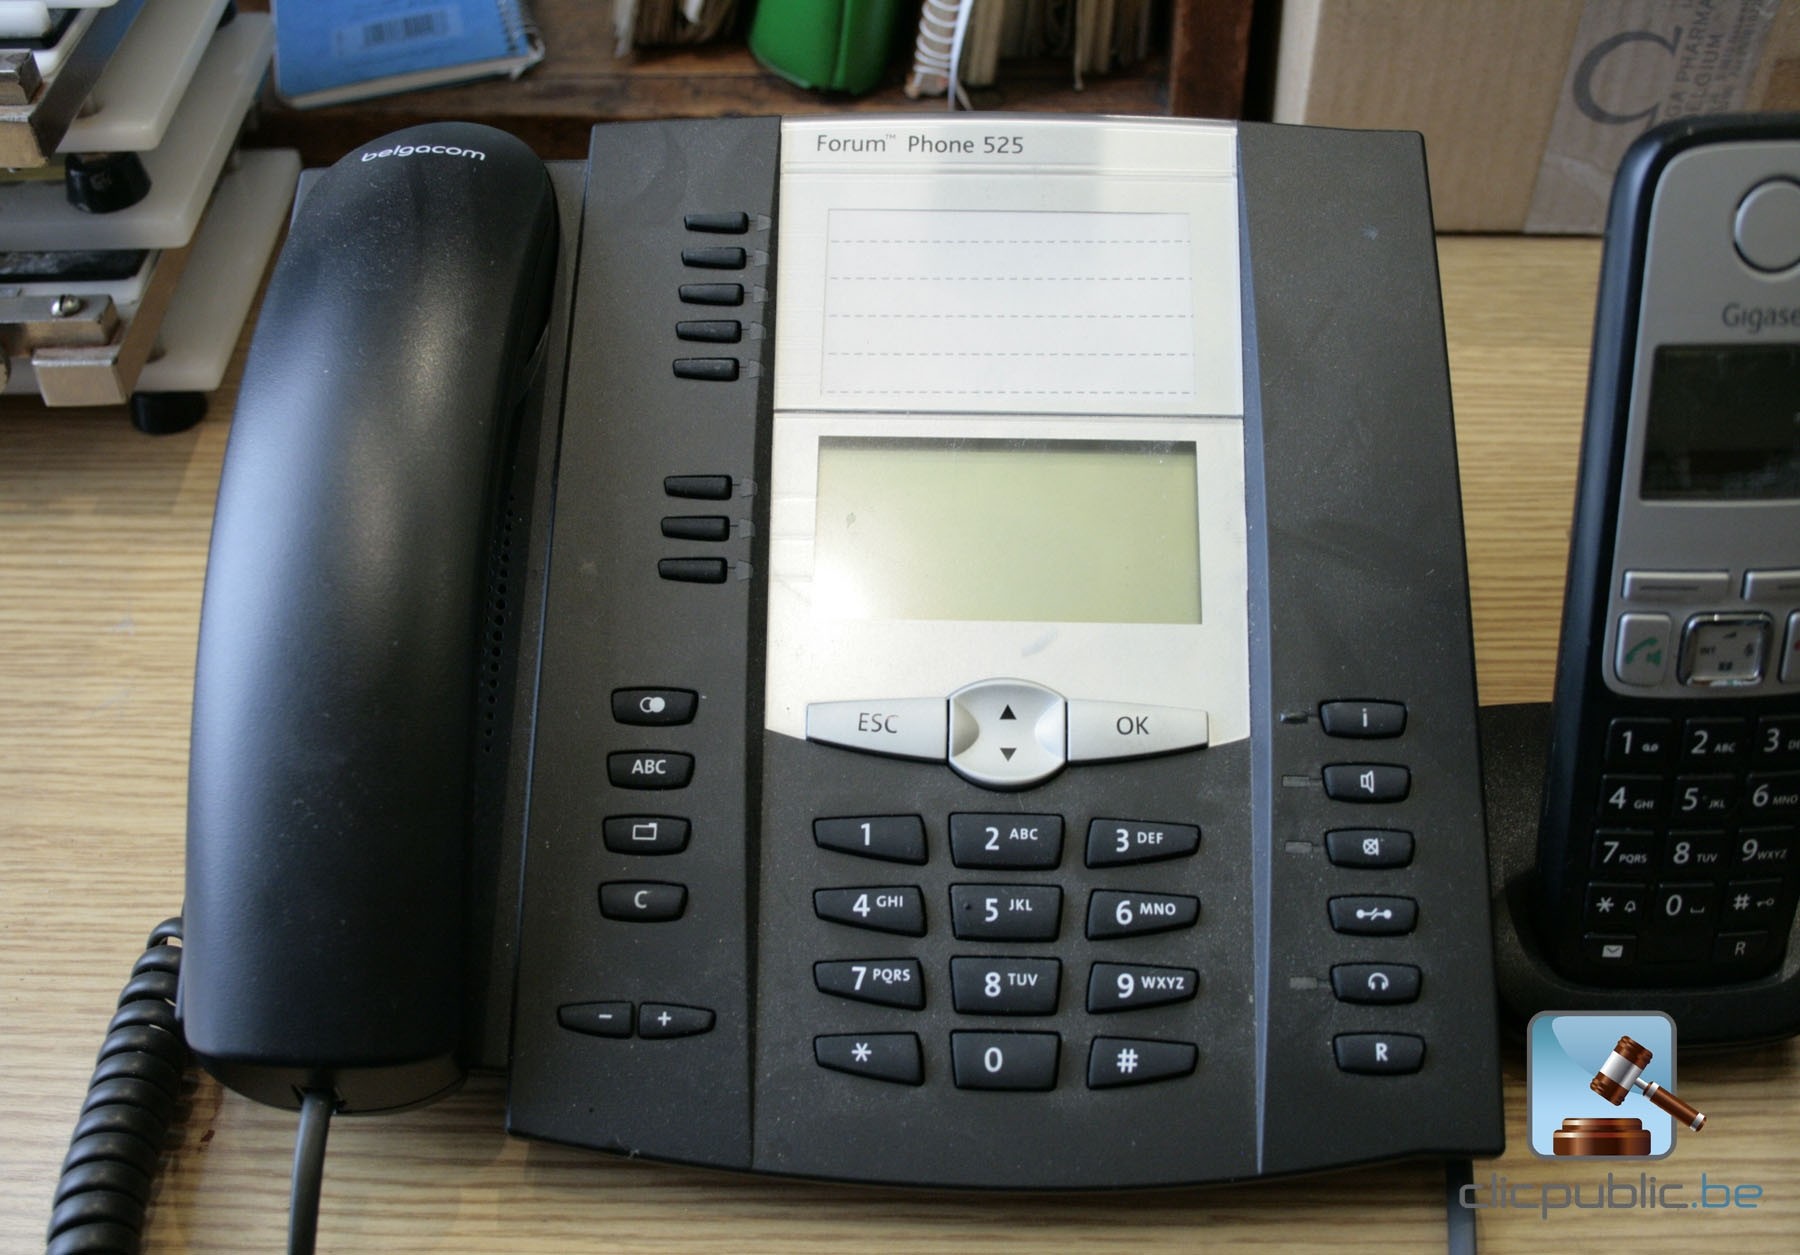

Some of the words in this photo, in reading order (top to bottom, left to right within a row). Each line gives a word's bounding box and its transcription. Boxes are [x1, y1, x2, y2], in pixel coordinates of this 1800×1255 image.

[360, 144, 486, 163] belgacom
[908, 134, 975, 154] Phone
[983, 136, 1024, 154] 525
[857, 712, 898, 734] ESC
[1116, 716, 1150, 736] OK
[1622, 730, 1633, 755] 1
[1691, 729, 1709, 755] 2
[1714, 742, 1735, 753] ABC
[1763, 727, 1780, 753] 3
[631, 759, 667, 775] ABC
[1608, 786, 1626, 809] 4
[1633, 799, 1654, 810] GHI
[1681, 787, 1699, 811] 5
[1708, 799, 1725, 809] JKL
[1752, 783, 1769, 807] 6
[1772, 794, 1799, 805] MNO
[860, 822, 871, 846] 1
[985, 826, 1000, 851] 2
[1009, 827, 1038, 841] ABC
[1116, 828, 1130, 853] 3
[1137, 831, 1164, 845] DEF
[1603, 840, 1620, 863] 7
[1618, 853, 1647, 864] PQRS
[1673, 841, 1691, 865] 8
[1697, 853, 1718, 863] TUV
[1742, 838, 1760, 861] 9
[1757, 849, 1787, 860] WXYZ
[634, 890, 649, 909] C
[852, 893, 871, 918] 4
[876, 895, 904, 908] GHI
[985, 897, 999, 922] 5
[1008, 898, 1033, 912] JKL
[1665, 894, 1683, 916] 0
[1115, 900, 1133, 925] 6
[1139, 902, 1177, 916] MNO
[1734, 941, 1747, 956] R
[851, 965, 867, 991] 7
[872, 968, 911, 984] PQRS
[984, 971, 1001, 998] 8
[1007, 972, 1039, 987] TUV
[1116, 972, 1135, 999] 9
[1140, 975, 1185, 990] WXYZ
[984, 1046, 1003, 1073] 0
[1375, 1042, 1388, 1061] R
